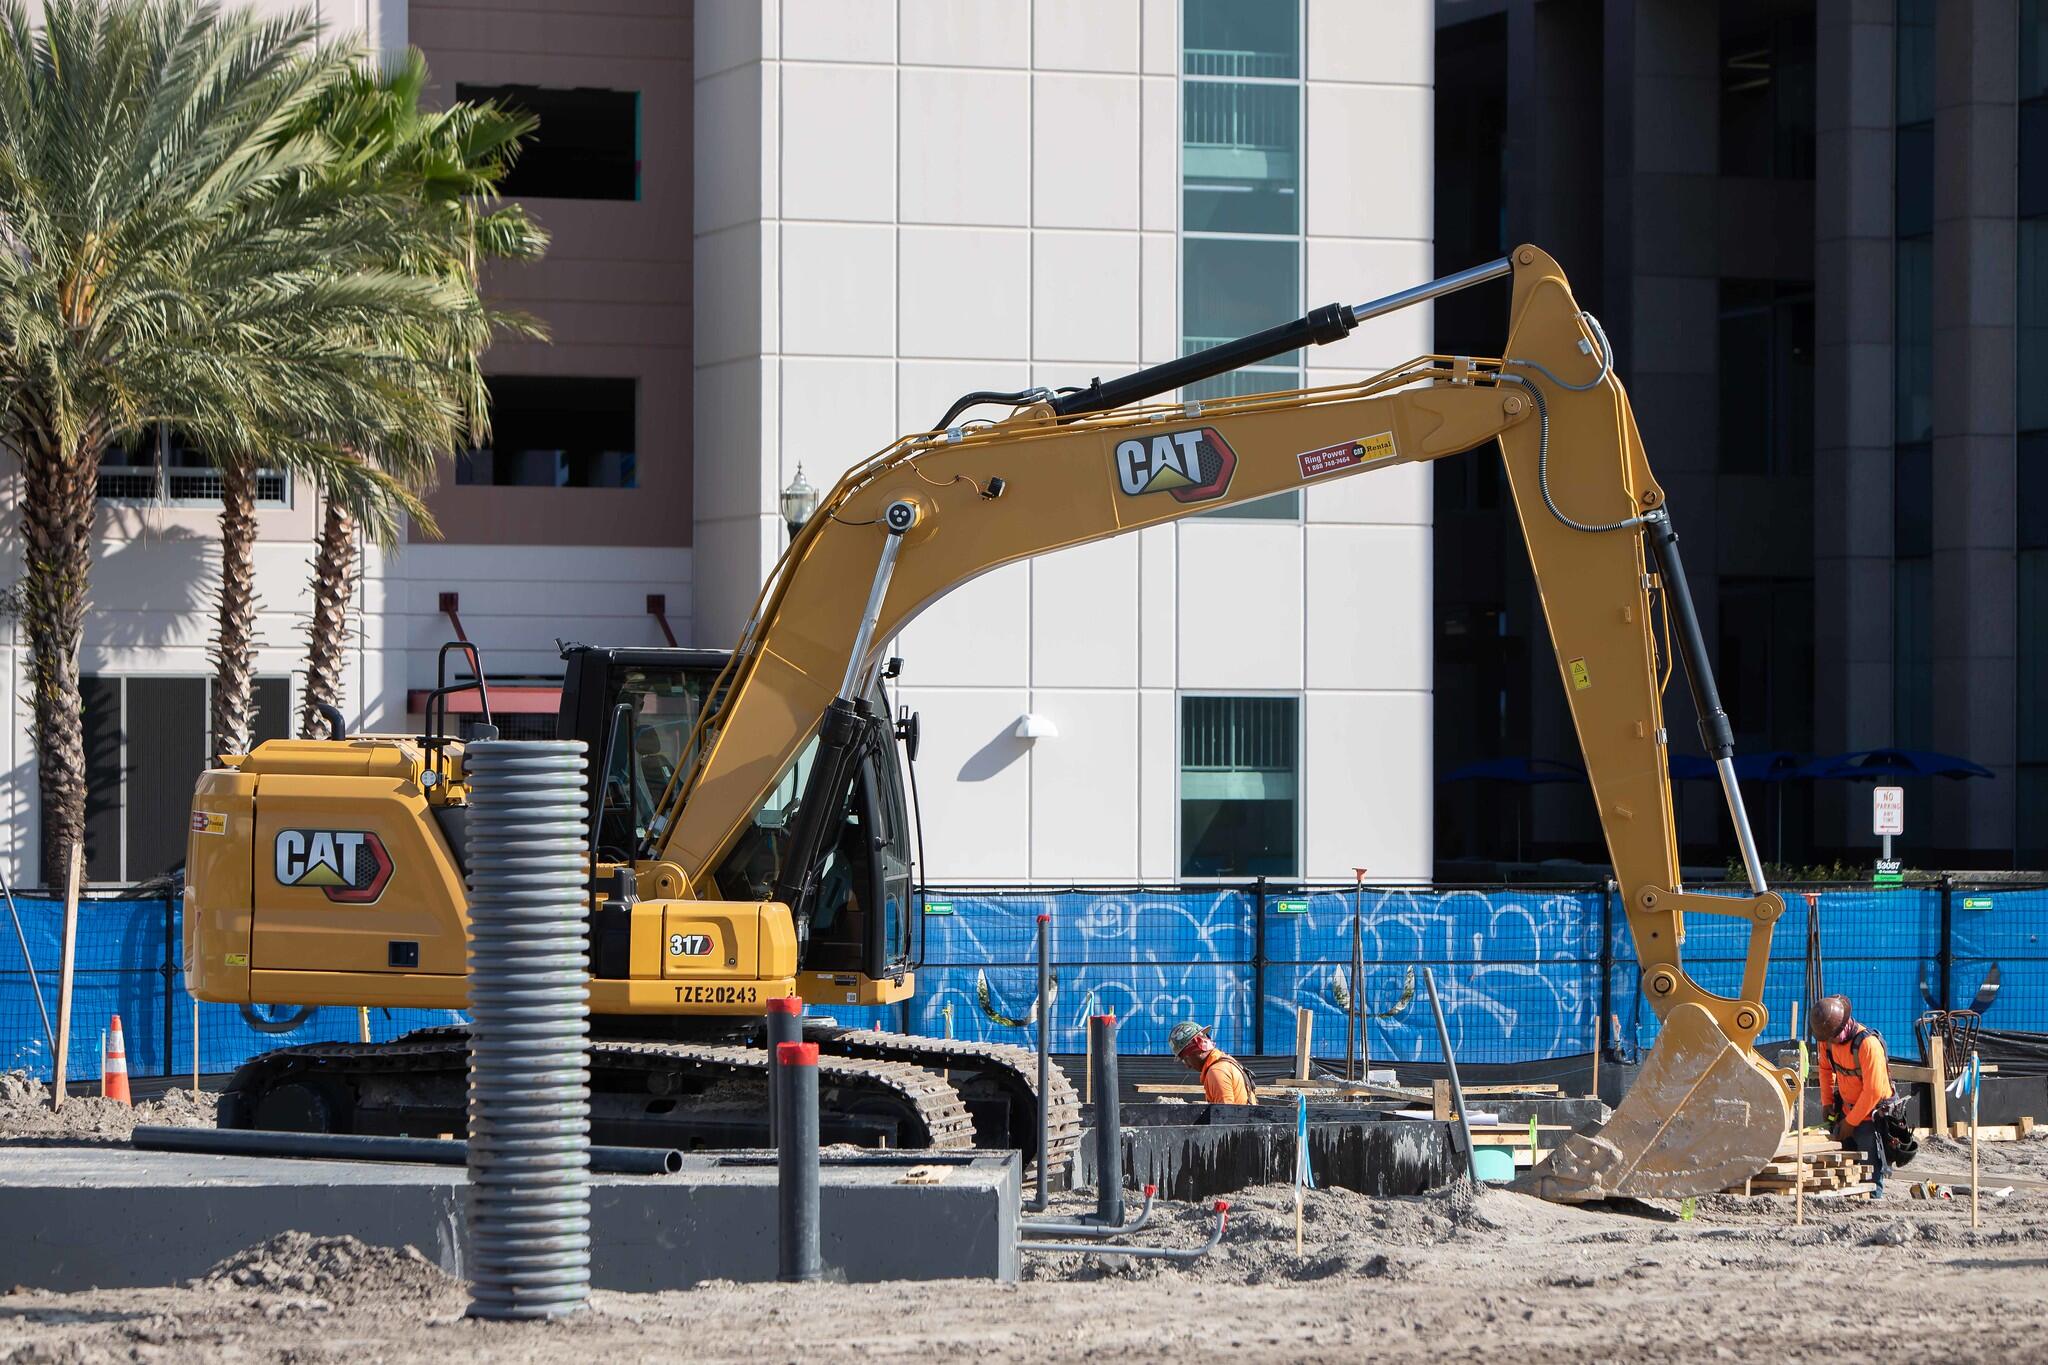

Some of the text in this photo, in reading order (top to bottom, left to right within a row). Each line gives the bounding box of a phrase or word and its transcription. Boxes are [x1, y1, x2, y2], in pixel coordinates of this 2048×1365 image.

[1304, 449, 1346, 464] Ring Power
[1353, 441, 1391, 456] CAT Rental
[1116, 430, 1203, 495] CAT
[1883, 792, 1894, 801] NO
[276, 830, 364, 886] CAT
[670, 934, 704, 955] 317
[675, 986, 757, 1003] TZE20243
